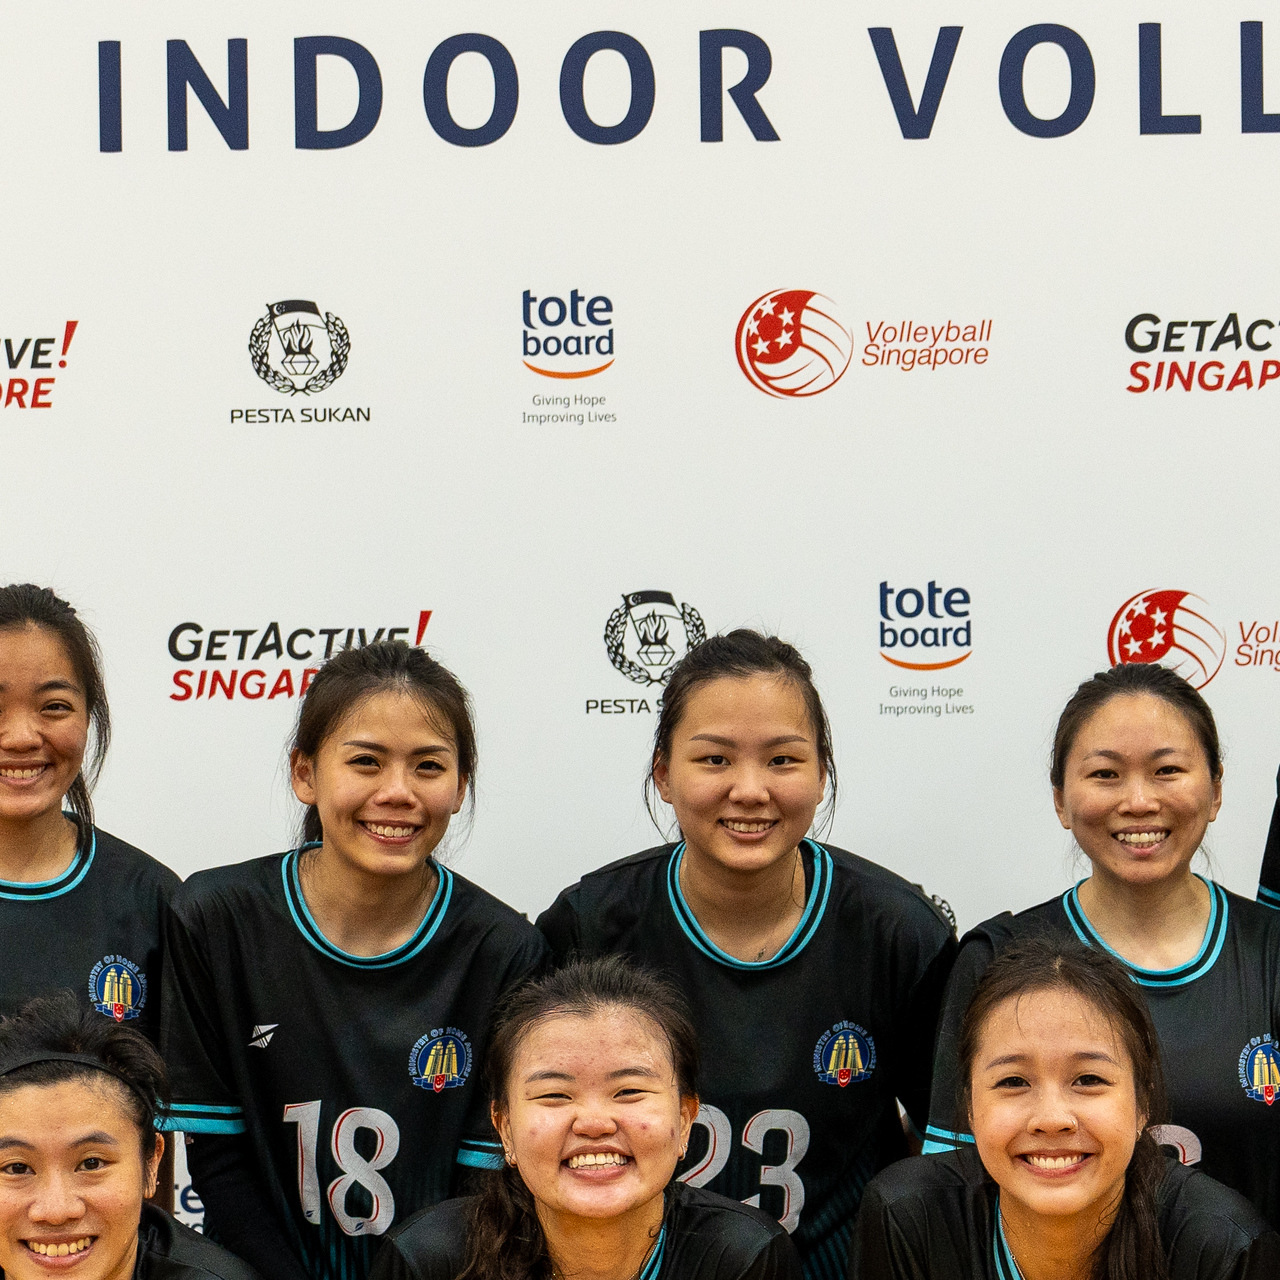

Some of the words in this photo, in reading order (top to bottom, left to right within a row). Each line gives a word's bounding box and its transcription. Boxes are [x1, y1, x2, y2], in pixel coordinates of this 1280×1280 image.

[98, 28, 781, 153] INDOOR
[523, 289, 613, 330] tote
[523, 328, 614, 356] board
[866, 319, 993, 346] Volleyball
[862, 343, 990, 371] Singapore
[533, 395, 570, 408] Giving
[575, 394, 606, 407] Hope
[231, 409, 295, 423] PESTA
[301, 408, 370, 422] SUKAN
[523, 412, 584, 425] Improving
[588, 411, 617, 422] Lives
[880, 580, 970, 621] tote
[880, 620, 971, 648] board
[586, 699, 651, 714] PESTA
[890, 686, 927, 700] Giving
[932, 686, 963, 699] Hope
[880, 704, 941, 717] Improving
[946, 704, 974, 714] Lives
[283, 1100, 400, 1236] 18
